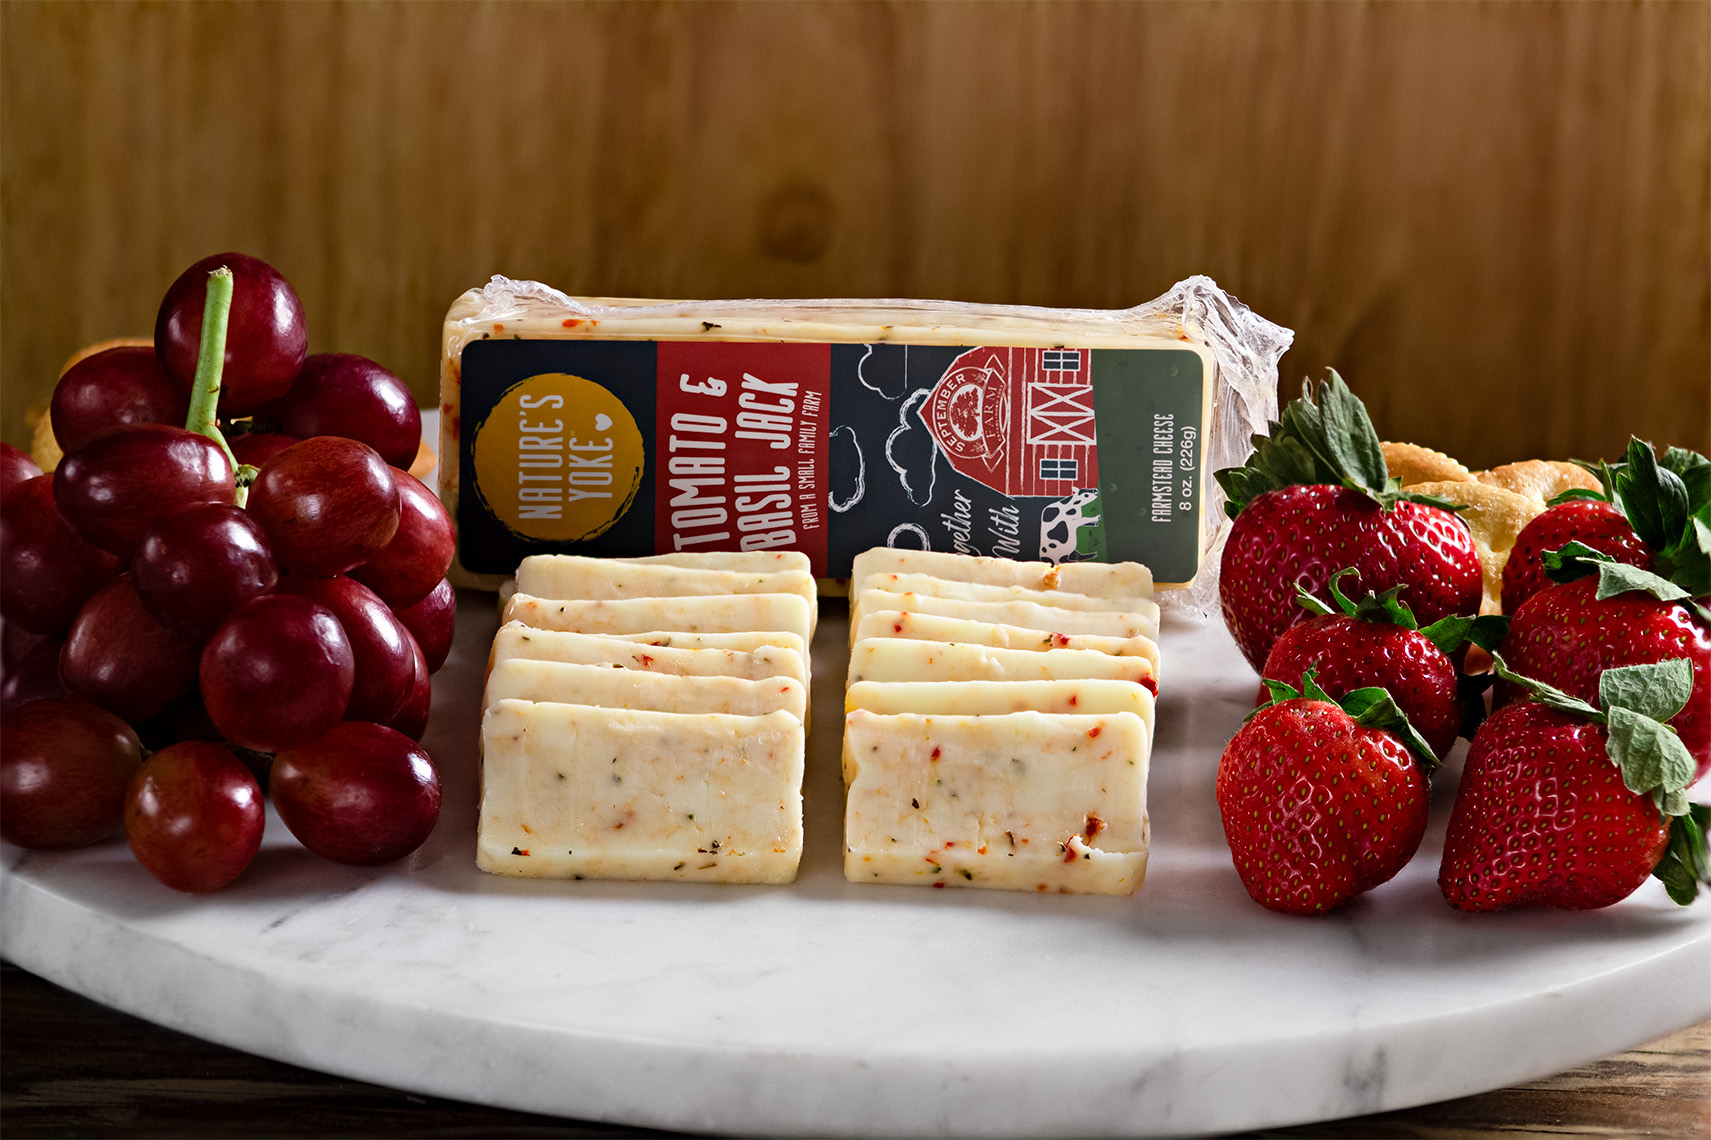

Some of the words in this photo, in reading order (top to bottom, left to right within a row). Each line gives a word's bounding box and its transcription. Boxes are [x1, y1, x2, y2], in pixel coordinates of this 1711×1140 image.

[679, 373, 728, 397] &
[801, 390, 822, 417] FARM
[735, 373, 799, 450] JACK
[936, 373, 966, 452] SEPTEMBER
[984, 386, 997, 438] FARM
[1153, 413, 1174, 454] CHEESE
[518, 394, 564, 519] NATURE'S
[798, 420, 817, 454] FAMILY
[1180, 426, 1197, 471] (226g)
[669, 412, 730, 551] TOMATO
[798, 458, 815, 490] SMALL
[1151, 459, 1173, 522] FARMSTEAD
[1182, 475, 1193, 498] oz.
[734, 465, 797, 552] BASIL
[800, 503, 820, 530] FROM
[940, 489, 982, 556] gether
[1179, 501, 1192, 511] 8
[988, 504, 1020, 559] With
